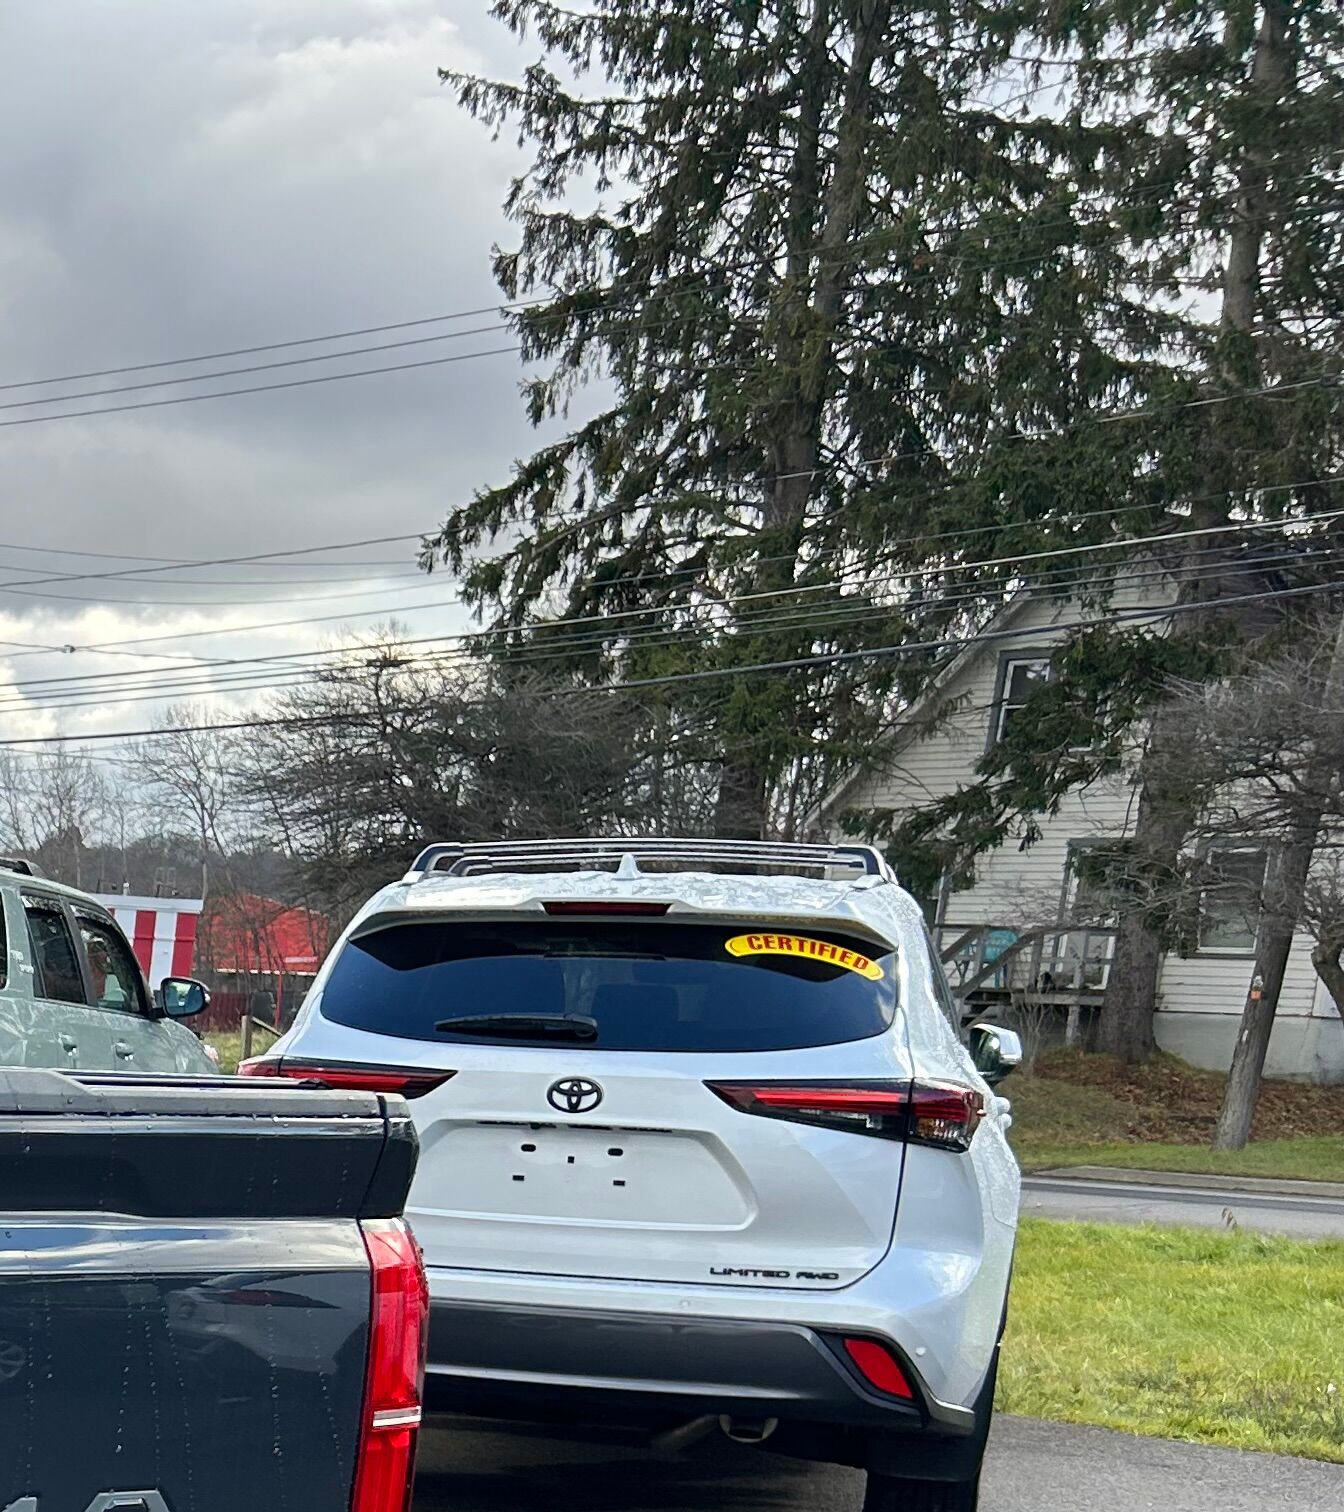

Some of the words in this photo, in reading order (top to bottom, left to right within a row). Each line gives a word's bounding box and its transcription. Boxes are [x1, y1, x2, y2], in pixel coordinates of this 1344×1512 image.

[746, 935, 869, 970] CERTIFIED
[709, 1267, 790, 1279] LIMITED
[796, 1271, 840, 1280] AWD
